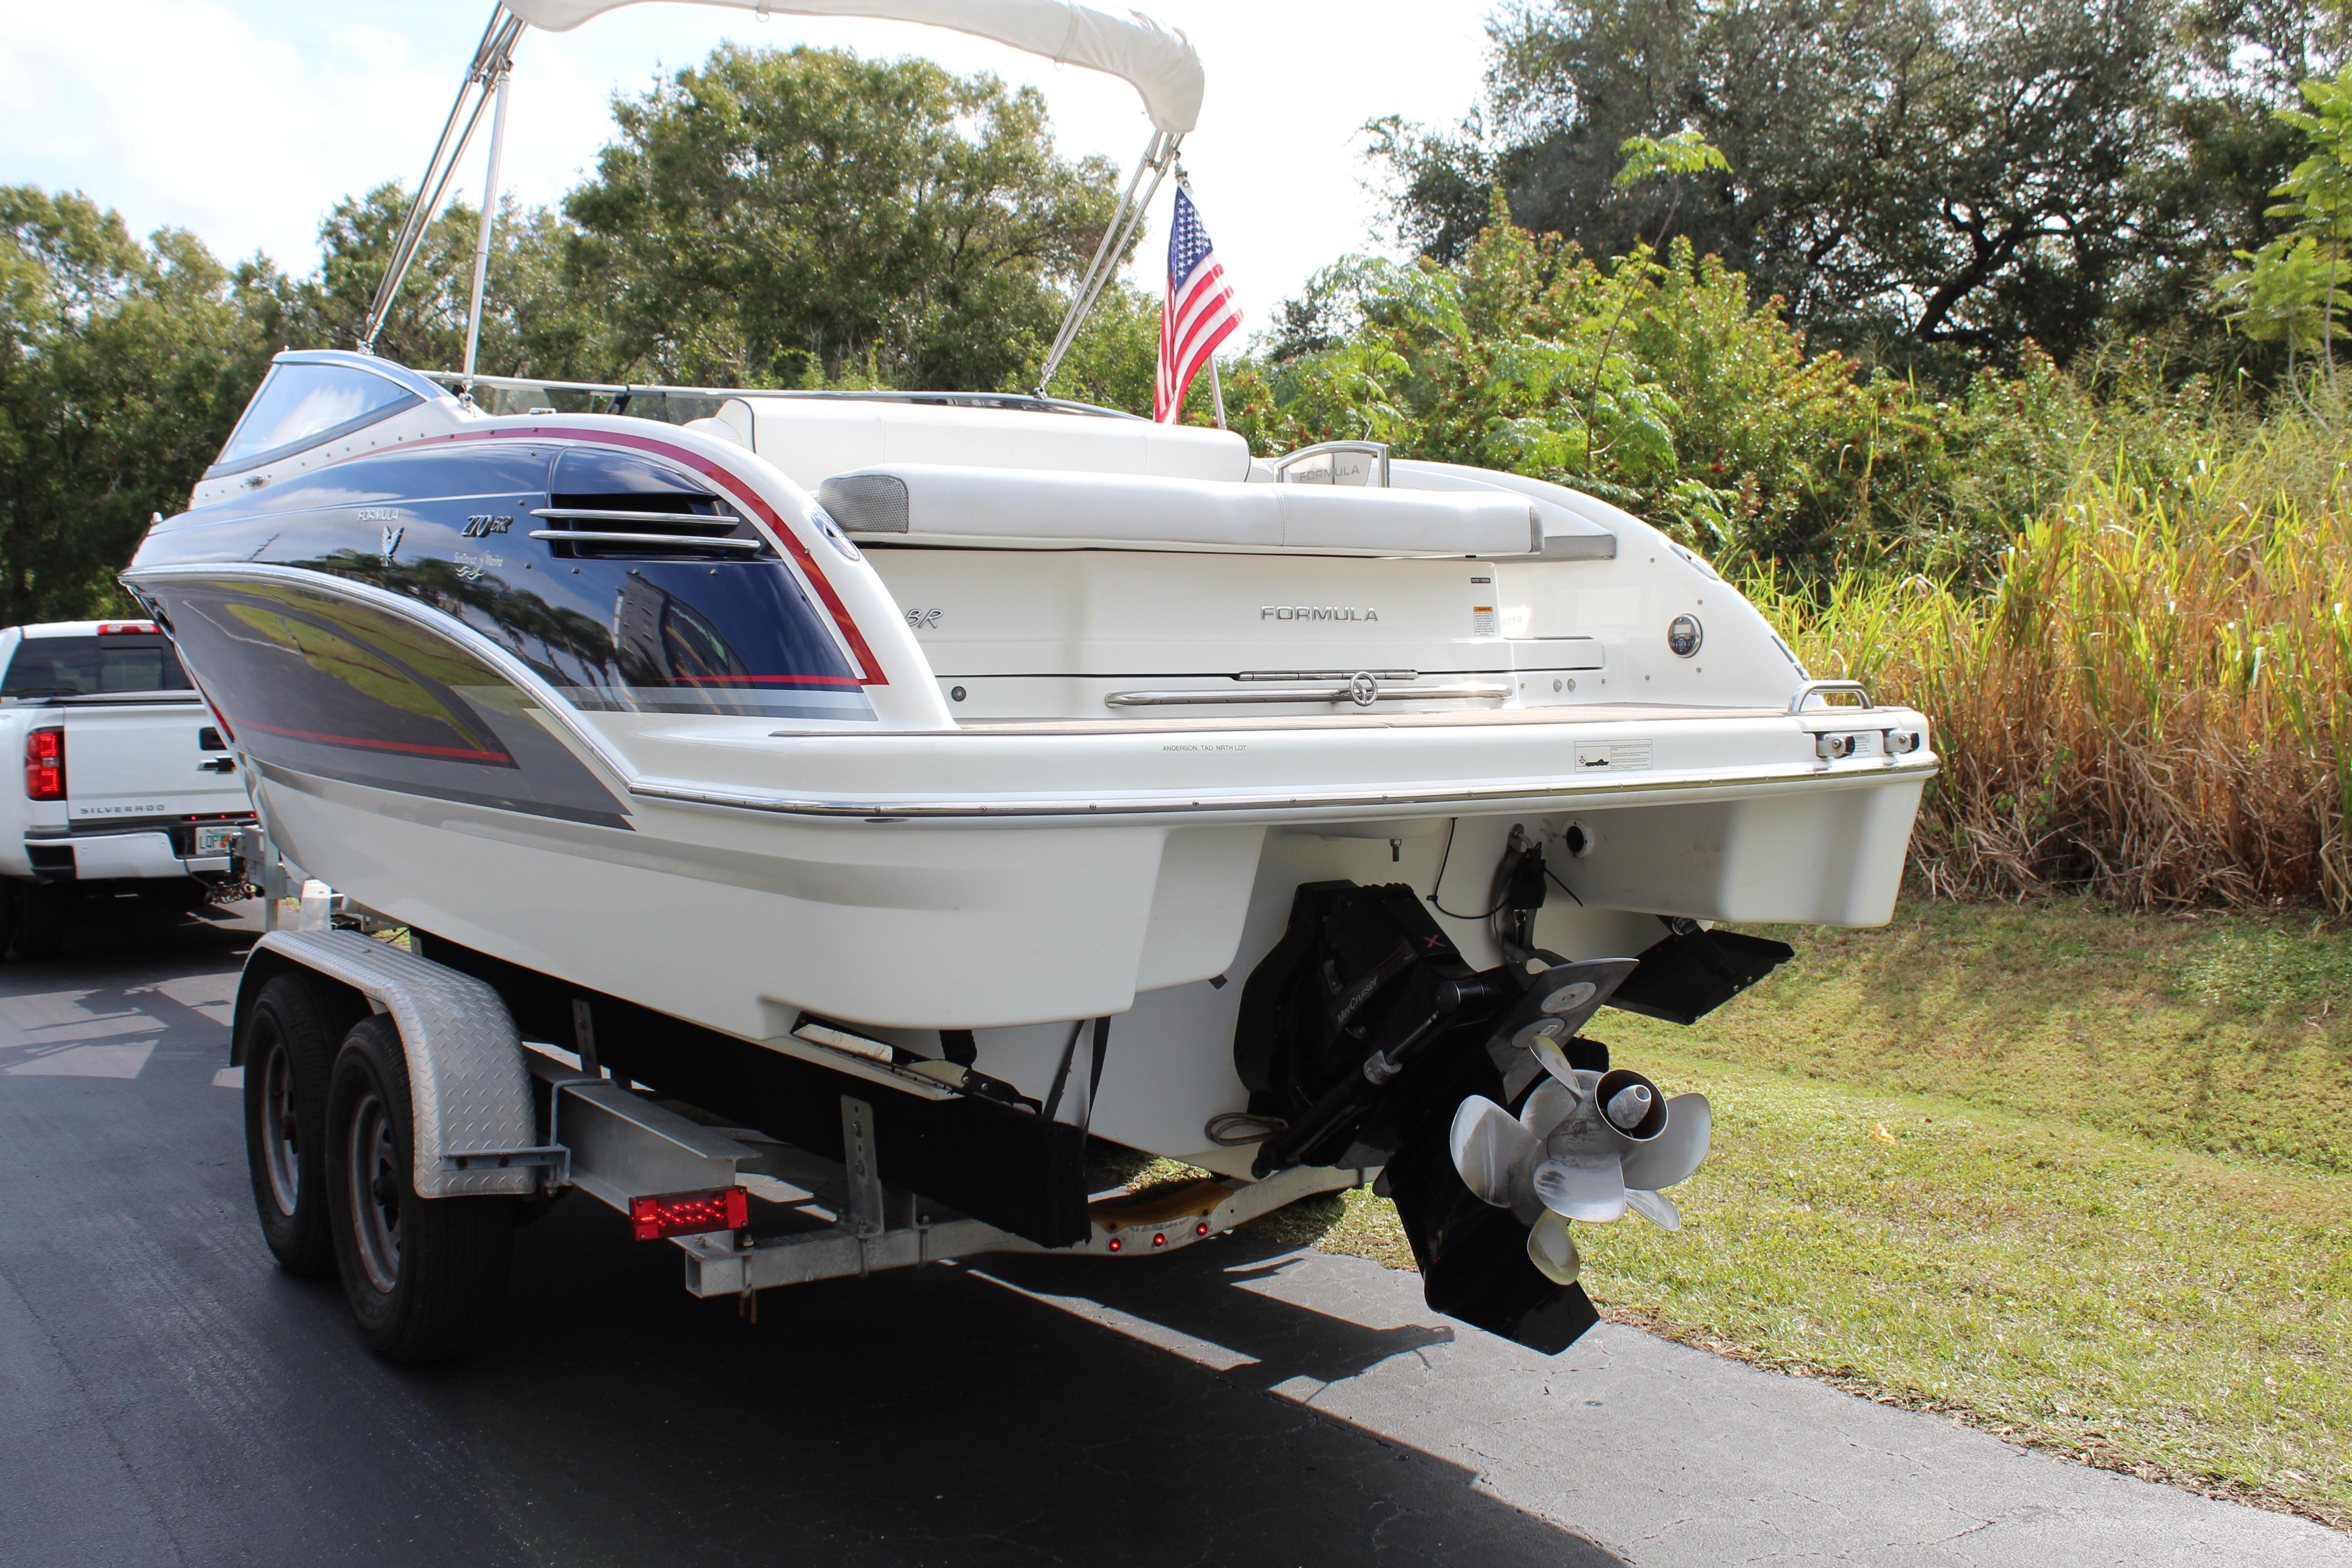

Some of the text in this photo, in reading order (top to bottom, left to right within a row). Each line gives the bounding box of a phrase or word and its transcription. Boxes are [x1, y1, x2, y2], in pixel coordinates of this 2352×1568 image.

[1299, 465, 1360, 482] FORMULA
[357, 508, 400, 522] FORMULA
[461, 514, 494, 538] 270
[905, 608, 944, 629] BR
[1260, 606, 1380, 623] FORMULA
[80, 804, 165, 814] SILVERADO
[1338, 976, 1377, 1025] MerCruiser
